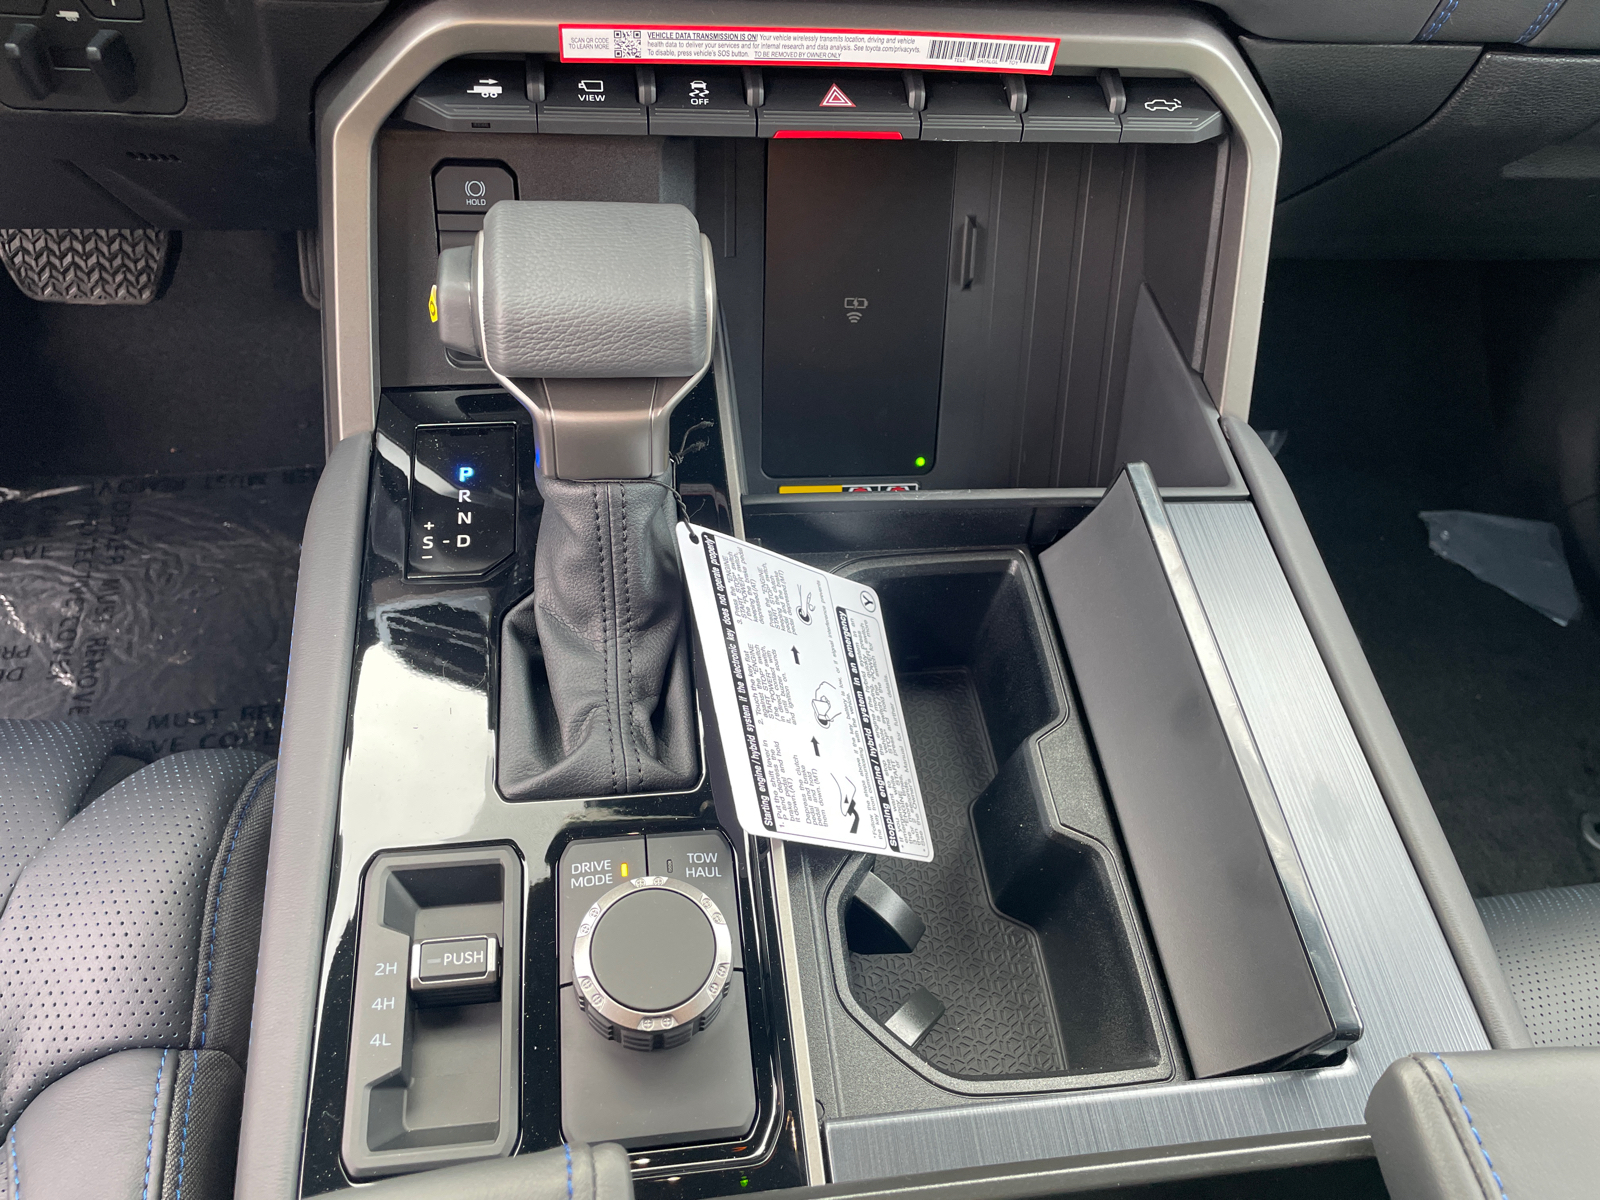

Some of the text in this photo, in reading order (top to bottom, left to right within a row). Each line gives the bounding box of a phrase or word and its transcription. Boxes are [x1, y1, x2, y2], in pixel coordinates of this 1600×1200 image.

[692, 32, 738, 40] TRANSMISSION
[793, 35, 818, 43] wirelessly
[844, 36, 866, 44] location,
[867, 36, 884, 44] driving
[830, 44, 852, 52] analysis.
[865, 45, 920, 54] toyota.com/privacyvts.
[578, 94, 606, 102] VIEW
[465, 198, 486, 206] HOLD
[459, 467, 475, 482] P
[458, 489, 472, 503] R
[457, 511, 472, 525] N
[422, 534, 471, 550] S D
[712, 566, 725, 591] operate
[717, 593, 727, 605] not
[862, 595, 873, 606] Y
[721, 607, 731, 625] does
[726, 628, 735, 641] key
[839, 611, 857, 658] emergency
[728, 643, 742, 678] electronic
[850, 662, 858, 673] an
[737, 681, 746, 693] the
[853, 677, 860, 686] in
[857, 690, 869, 723] system
[147, 707, 228, 731] MUST
[742, 704, 755, 732] system
[746, 734, 760, 759] hybrid
[762, 739, 768, 747] in
[864, 727, 877, 757] hybrid
[764, 748, 772, 767] lever
[793, 754, 801, 775] clutch
[754, 765, 766, 792] engine
[768, 770, 776, 787] shift
[874, 765, 886, 797] engine
[760, 795, 773, 826] Starting
[775, 805, 784, 819] Put
[801, 793, 812, 824] Depress
[883, 803, 897, 846] Stopping
[686, 852, 718, 864] TOW
[571, 859, 612, 875] DRIVE
[685, 865, 722, 878] HAUL
[570, 874, 613, 889] MODE
[443, 951, 484, 966] PUSH
[375, 962, 398, 976] 2H
[371, 997, 395, 1011] 4H
[370, 1033, 391, 1046] 4L
